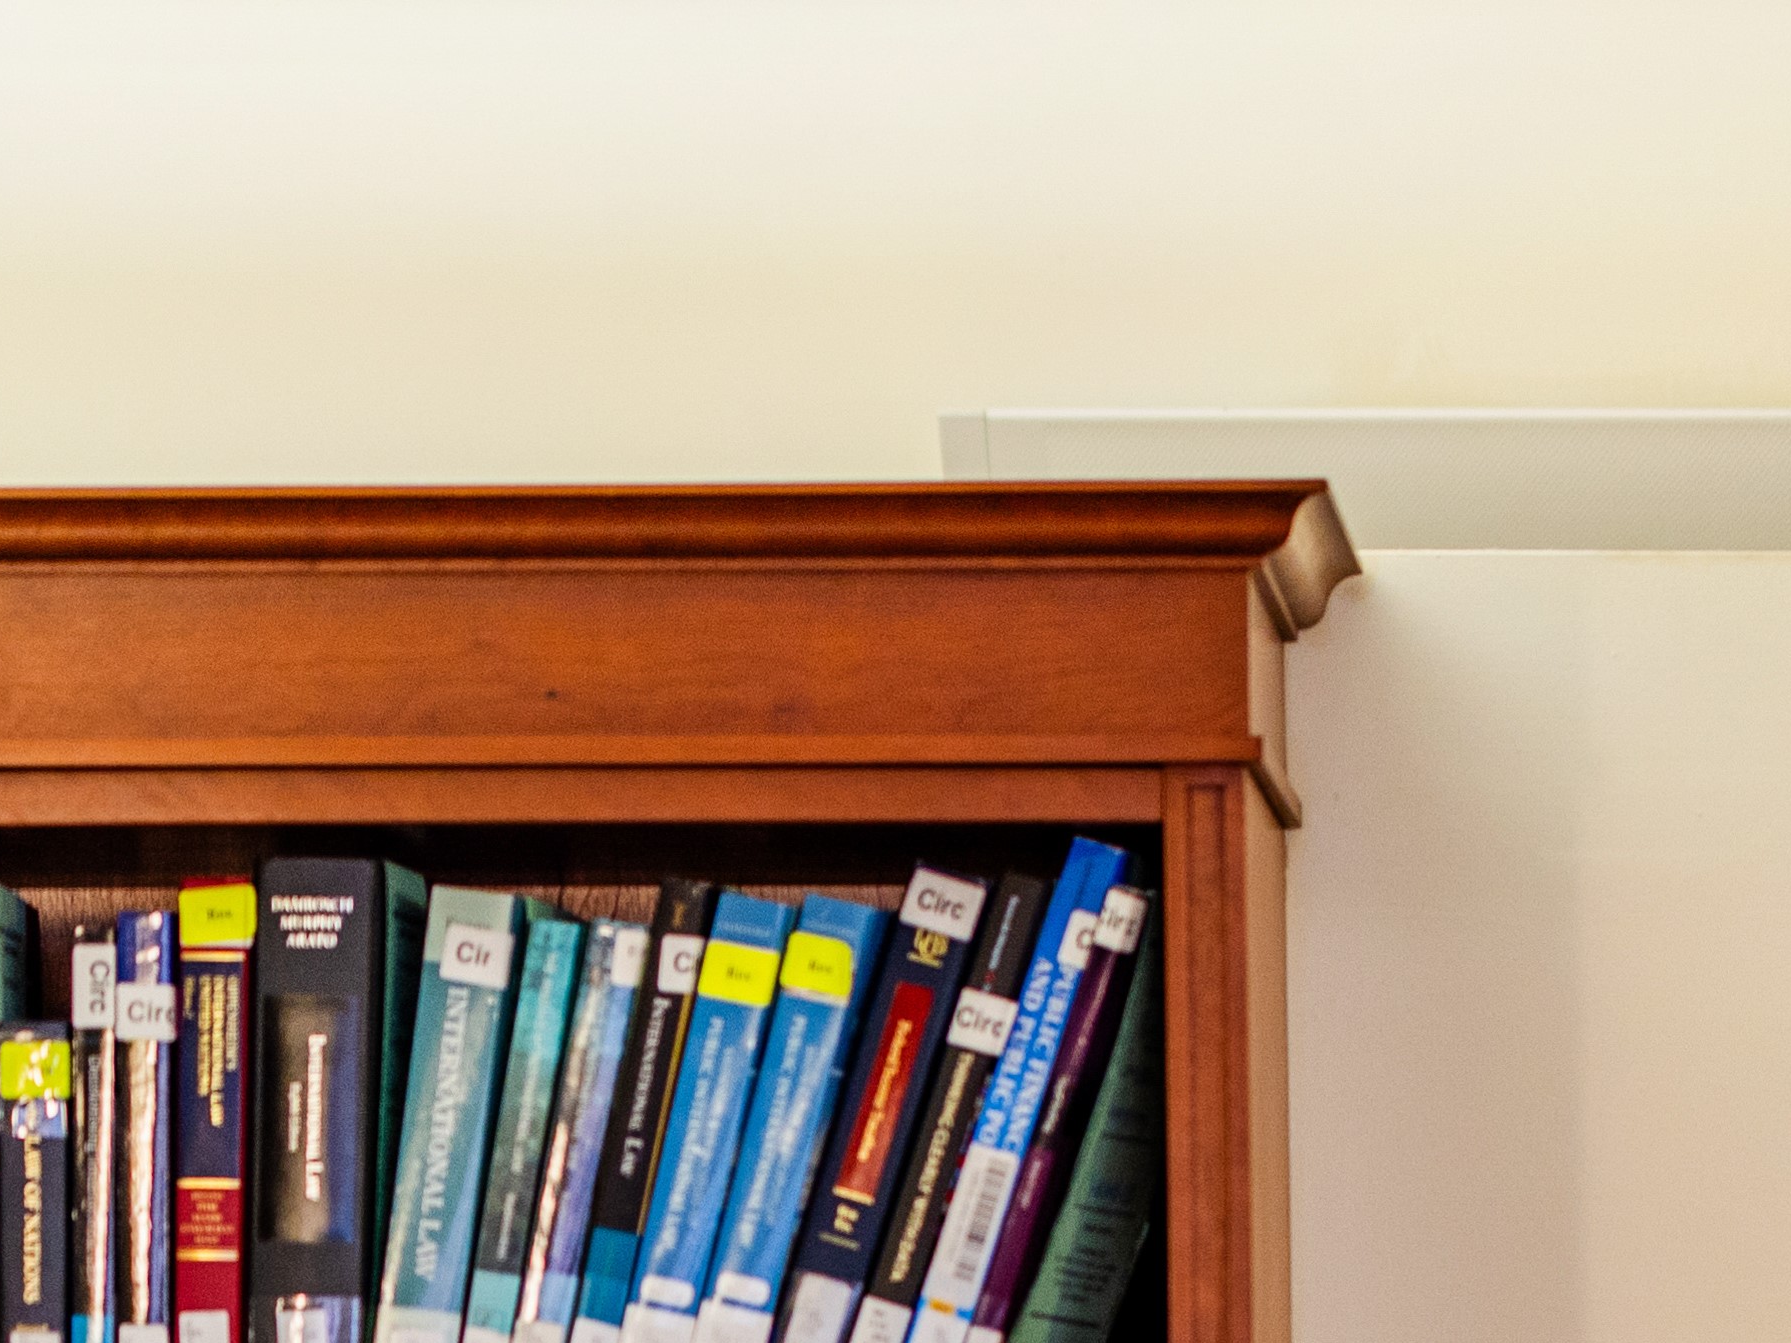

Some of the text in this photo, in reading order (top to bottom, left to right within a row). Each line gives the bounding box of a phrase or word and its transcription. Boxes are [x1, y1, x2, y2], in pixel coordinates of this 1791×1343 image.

[917, 889, 965, 919] Circ
[956, 1005, 1003, 1037] Circ
[991, 955, 1054, 1108] AND PUBLIC
[412, 985, 472, 1280] INTERNATIONAL LAW
